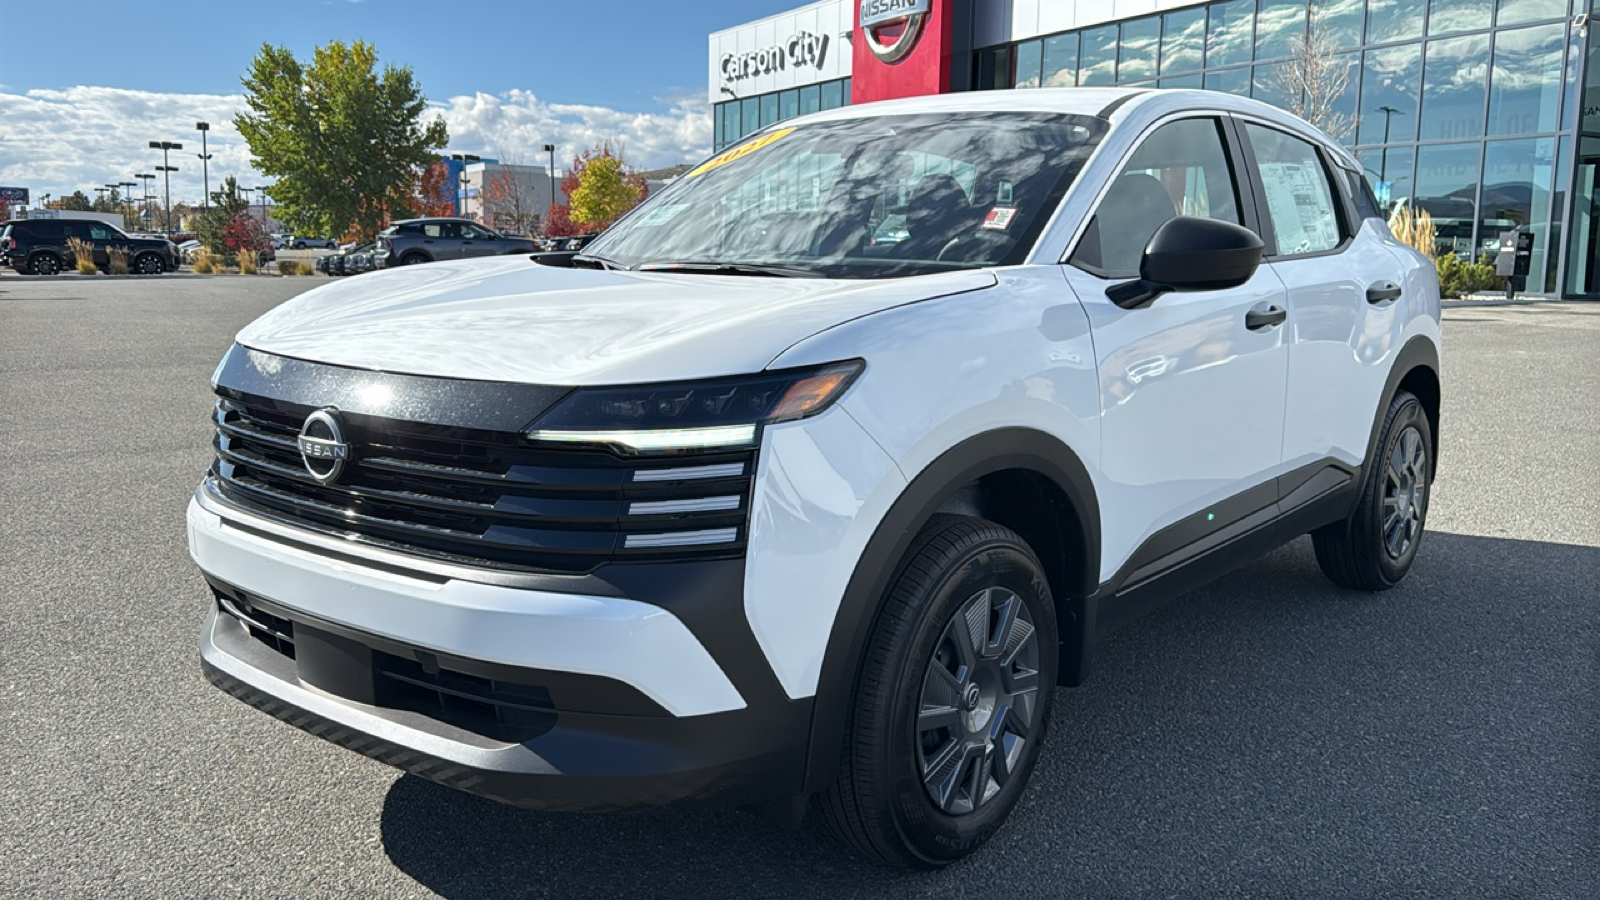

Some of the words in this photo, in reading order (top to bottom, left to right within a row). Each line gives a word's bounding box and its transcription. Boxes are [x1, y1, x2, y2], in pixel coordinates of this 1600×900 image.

[861, 0, 916, 19] NISSAN
[719, 45, 785, 82] Carson
[786, 30, 830, 71] City
